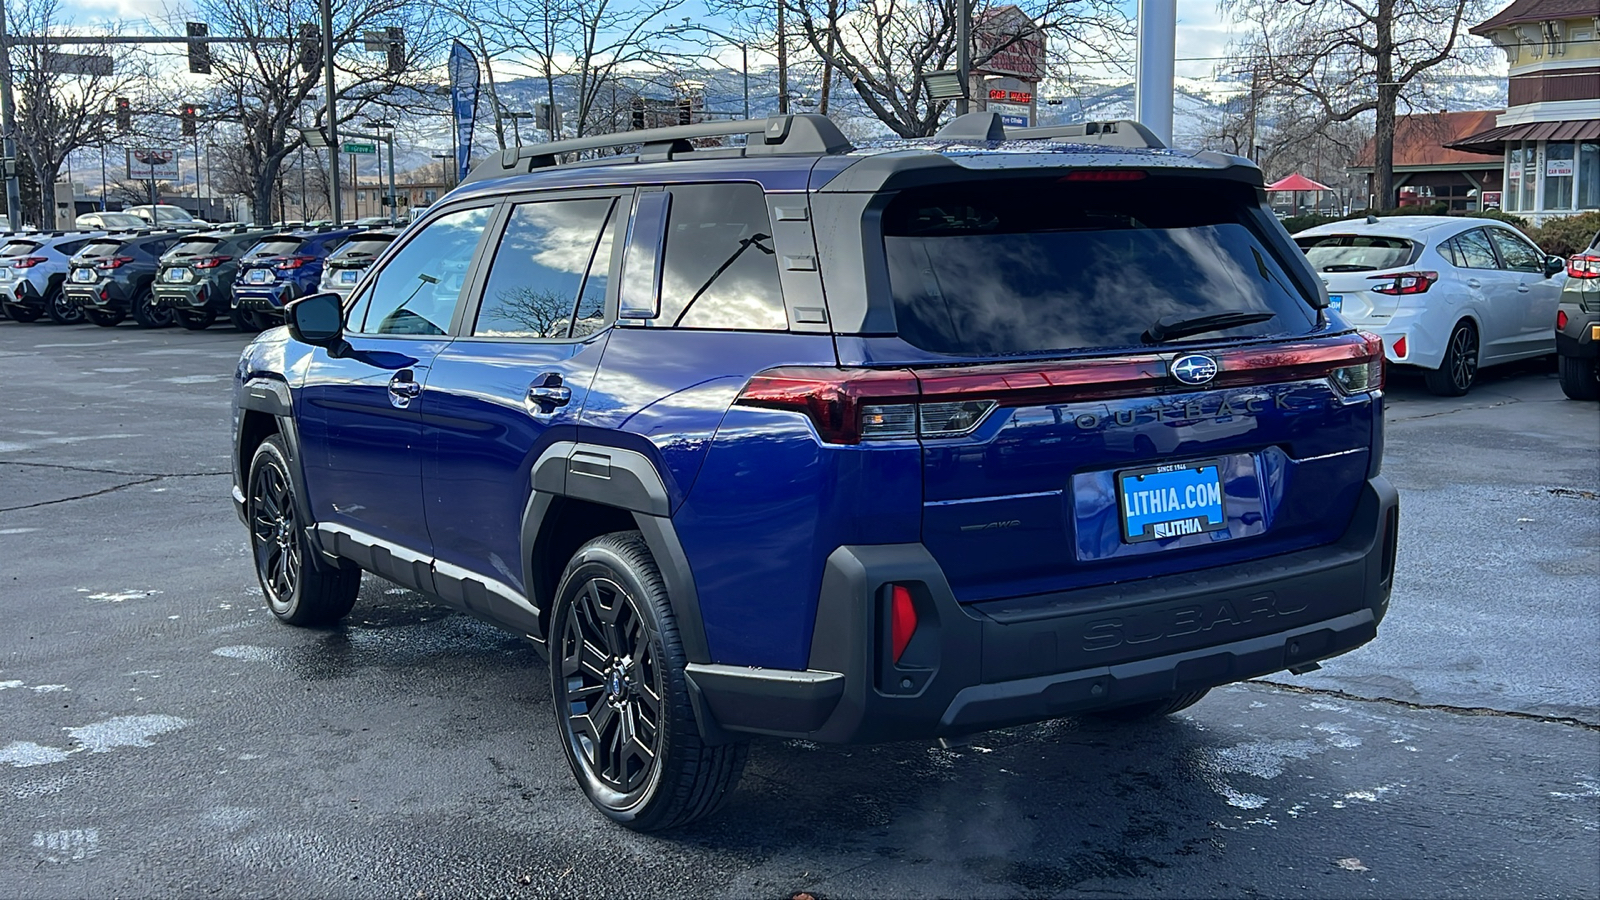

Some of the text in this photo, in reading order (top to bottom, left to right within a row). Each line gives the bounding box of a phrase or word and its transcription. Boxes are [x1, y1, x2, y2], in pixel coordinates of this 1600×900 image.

[1075, 394, 1289, 430] OUTBACK
[1157, 463, 1187, 473] SINCE 1946
[1124, 481, 1221, 517] LITHIA.COM
[1165, 518, 1203, 537] LITHIA
[1082, 588, 1310, 652] SUBARU
